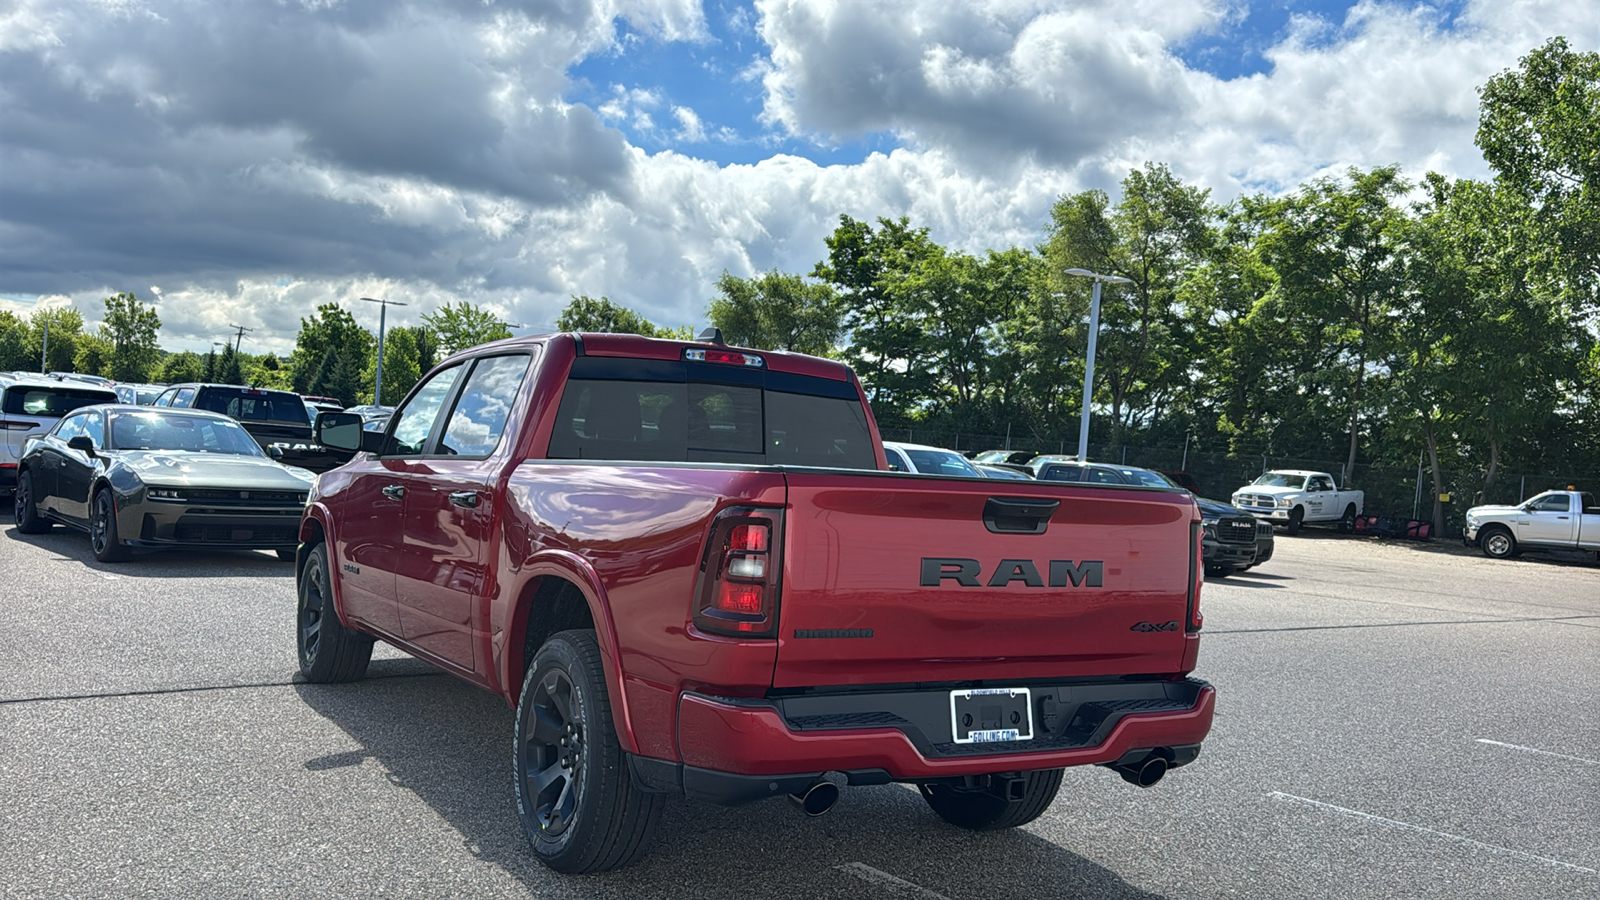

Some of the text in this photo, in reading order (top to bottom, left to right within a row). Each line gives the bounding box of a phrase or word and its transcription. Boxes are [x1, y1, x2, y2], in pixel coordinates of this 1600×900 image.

[273, 442, 326, 453] RAM
[920, 557, 1104, 588] RAM
[973, 731, 1016, 742] GOLLING.COM
